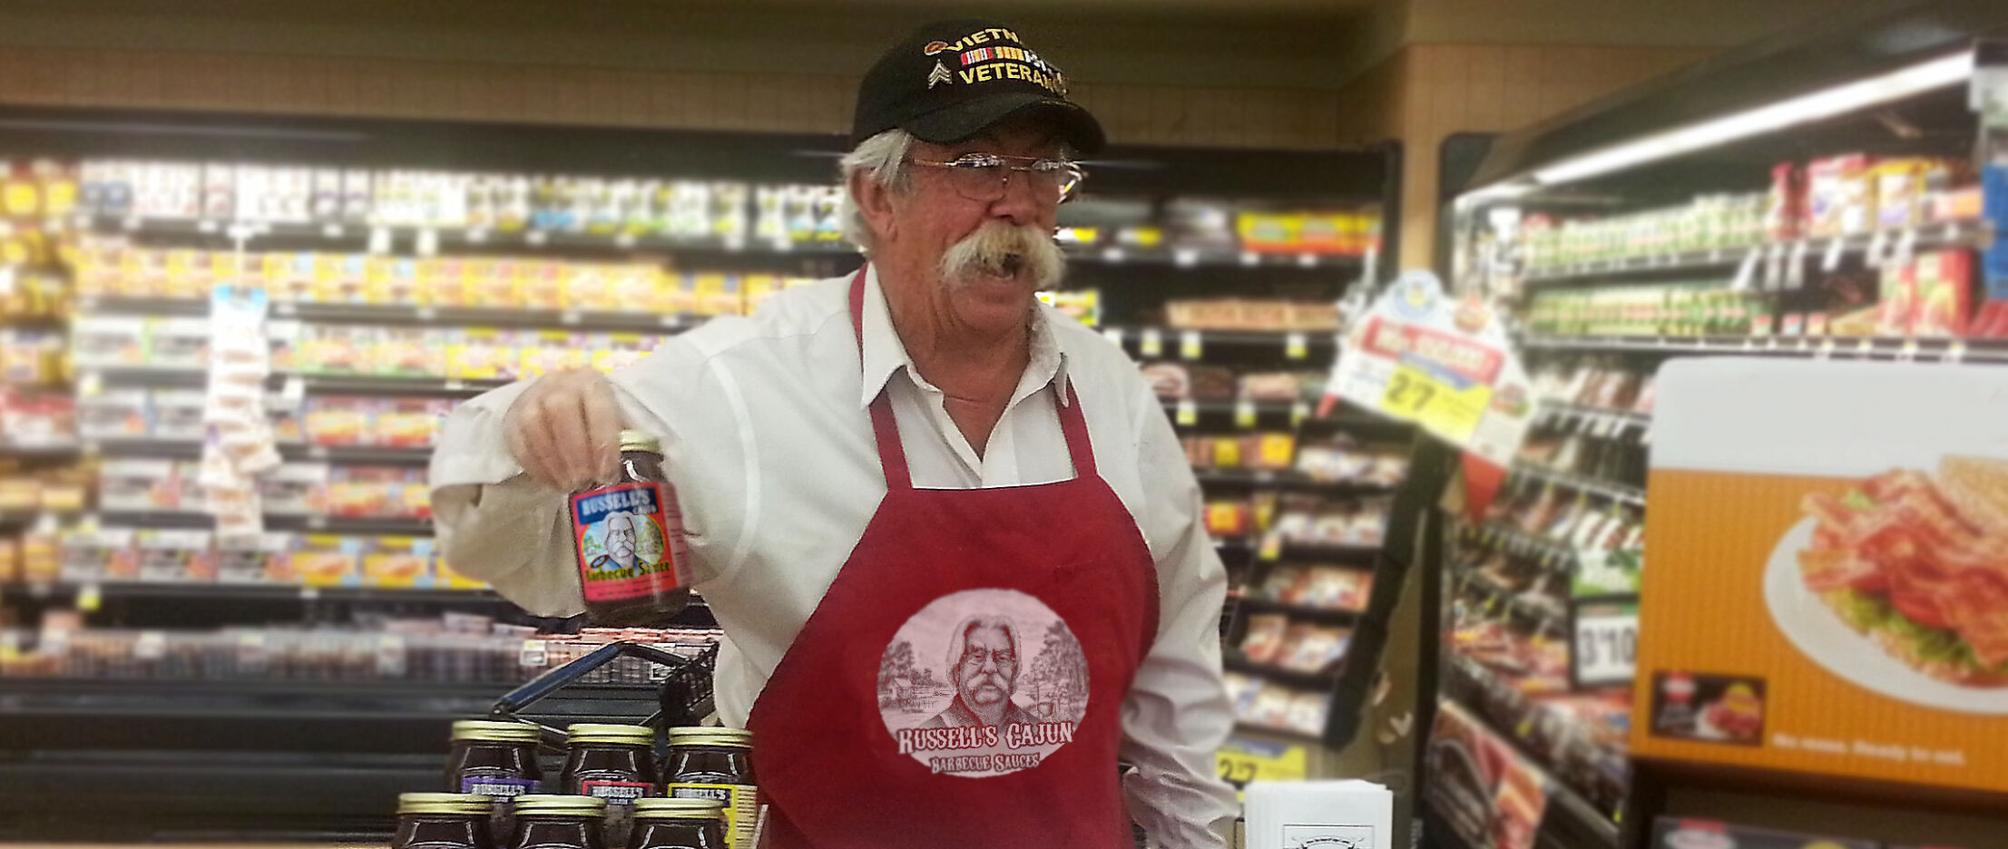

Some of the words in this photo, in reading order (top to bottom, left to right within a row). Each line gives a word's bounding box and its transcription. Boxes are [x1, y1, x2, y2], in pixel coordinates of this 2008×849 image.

[947, 28, 1022, 51] VIETN
[581, 489, 650, 516] RUSSELL'S
[898, 725, 998, 754] RUSSELL'S
[1006, 720, 1073, 748] CAJUN
[930, 755, 991, 774] BARBECUE
[994, 752, 1040, 772] SAUCES
